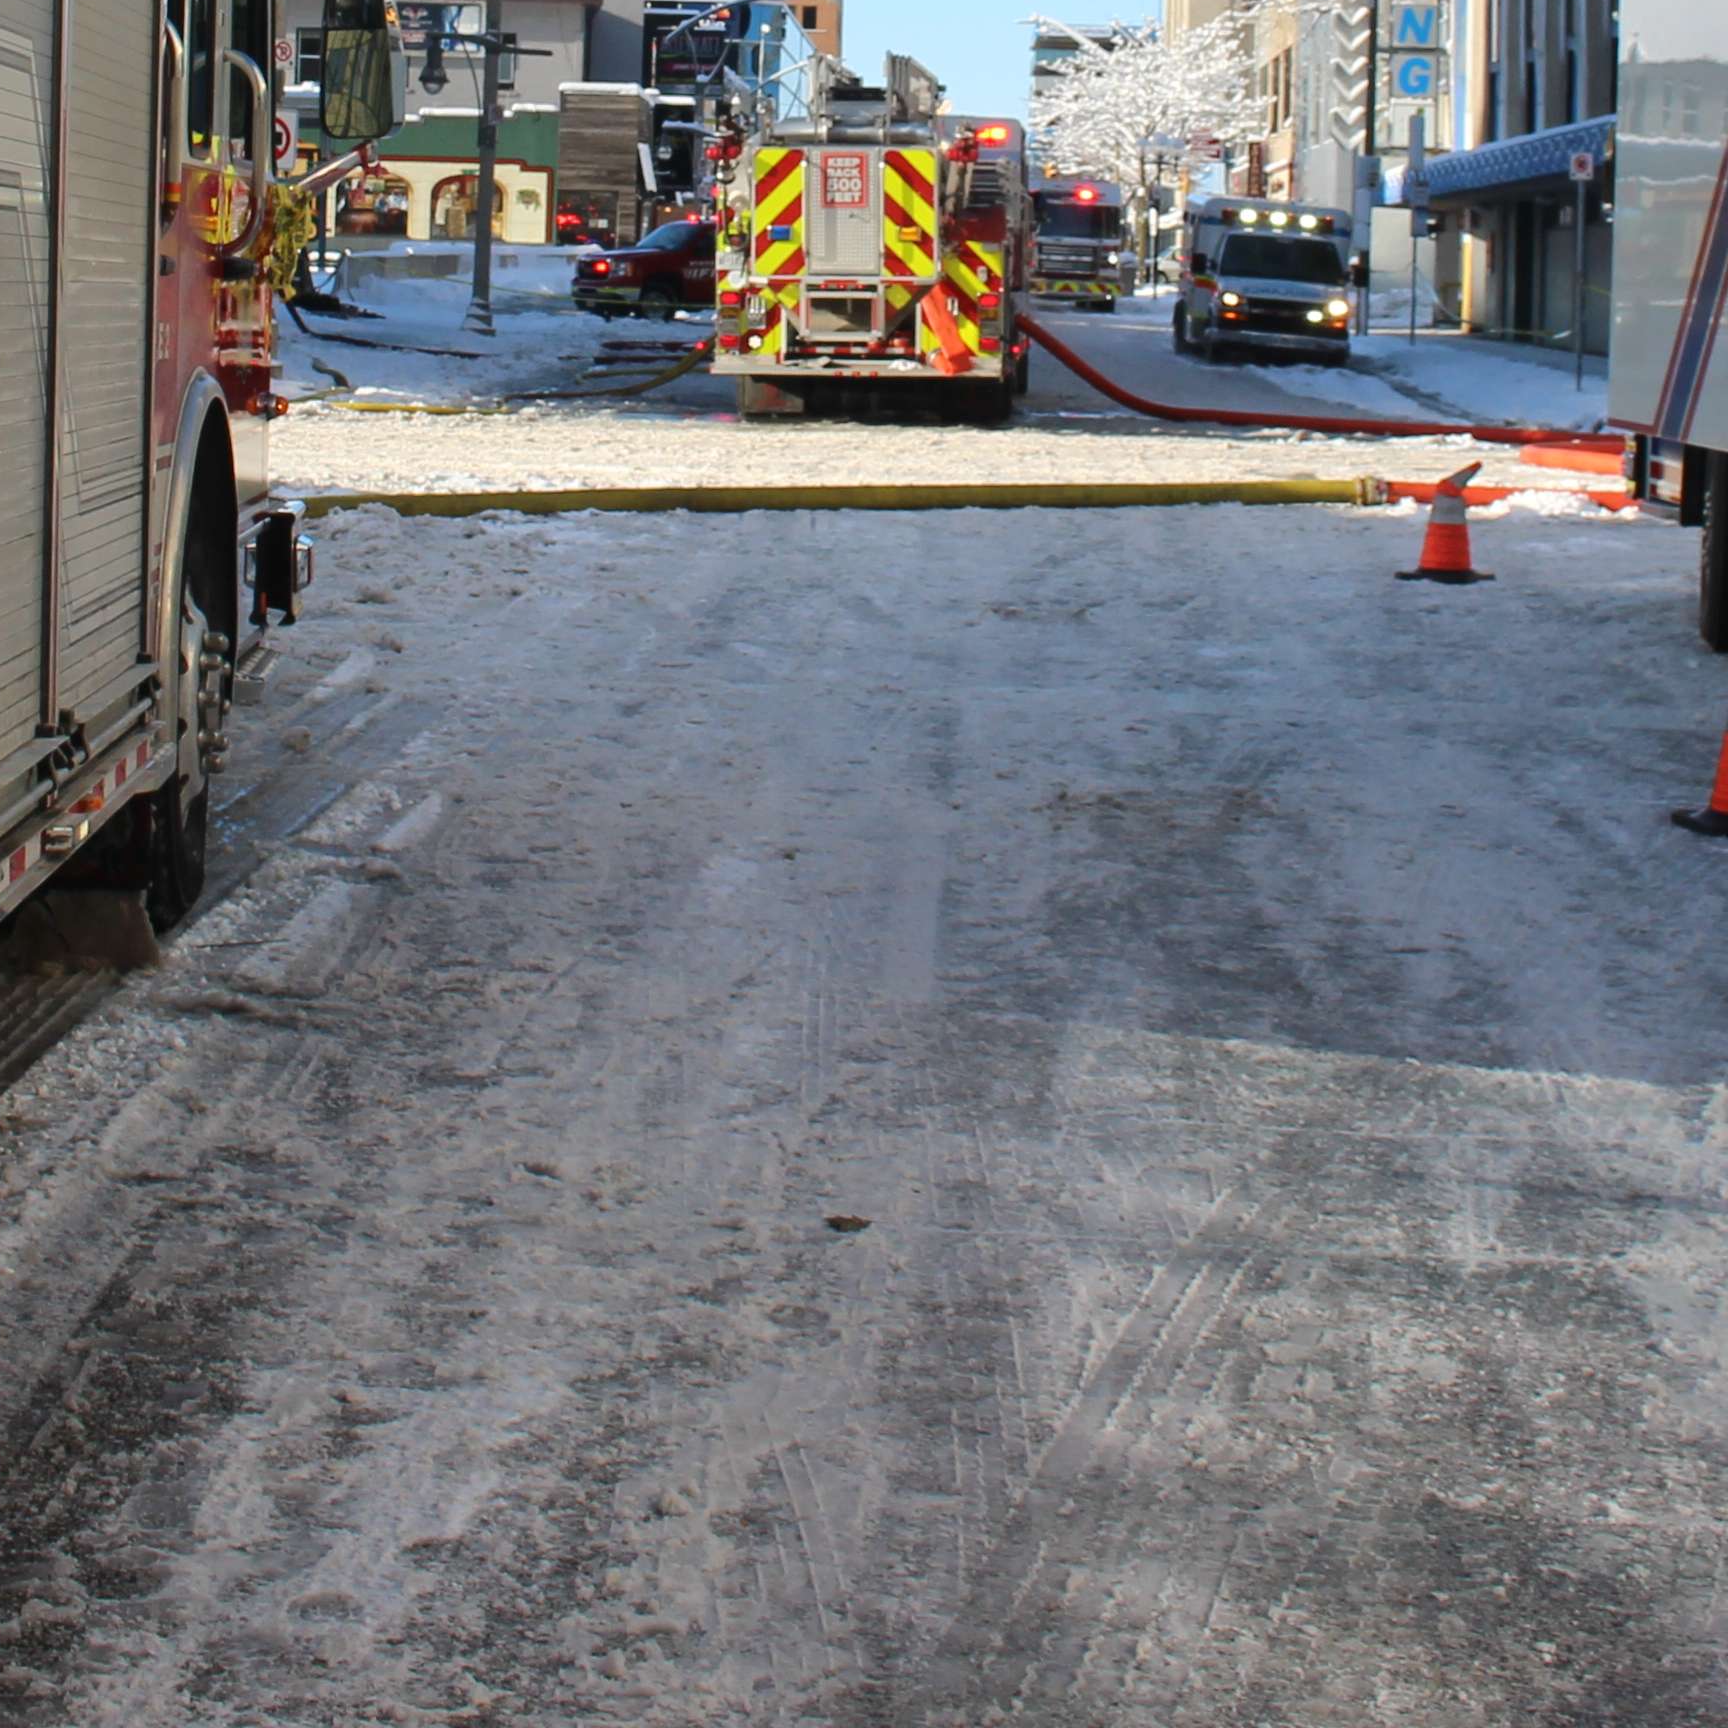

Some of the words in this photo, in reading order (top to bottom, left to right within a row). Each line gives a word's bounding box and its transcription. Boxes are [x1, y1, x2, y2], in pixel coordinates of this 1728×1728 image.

[827, 157, 861, 167] KEEP
[826, 168, 861, 177] BACK
[826, 192, 862, 202] FEET
